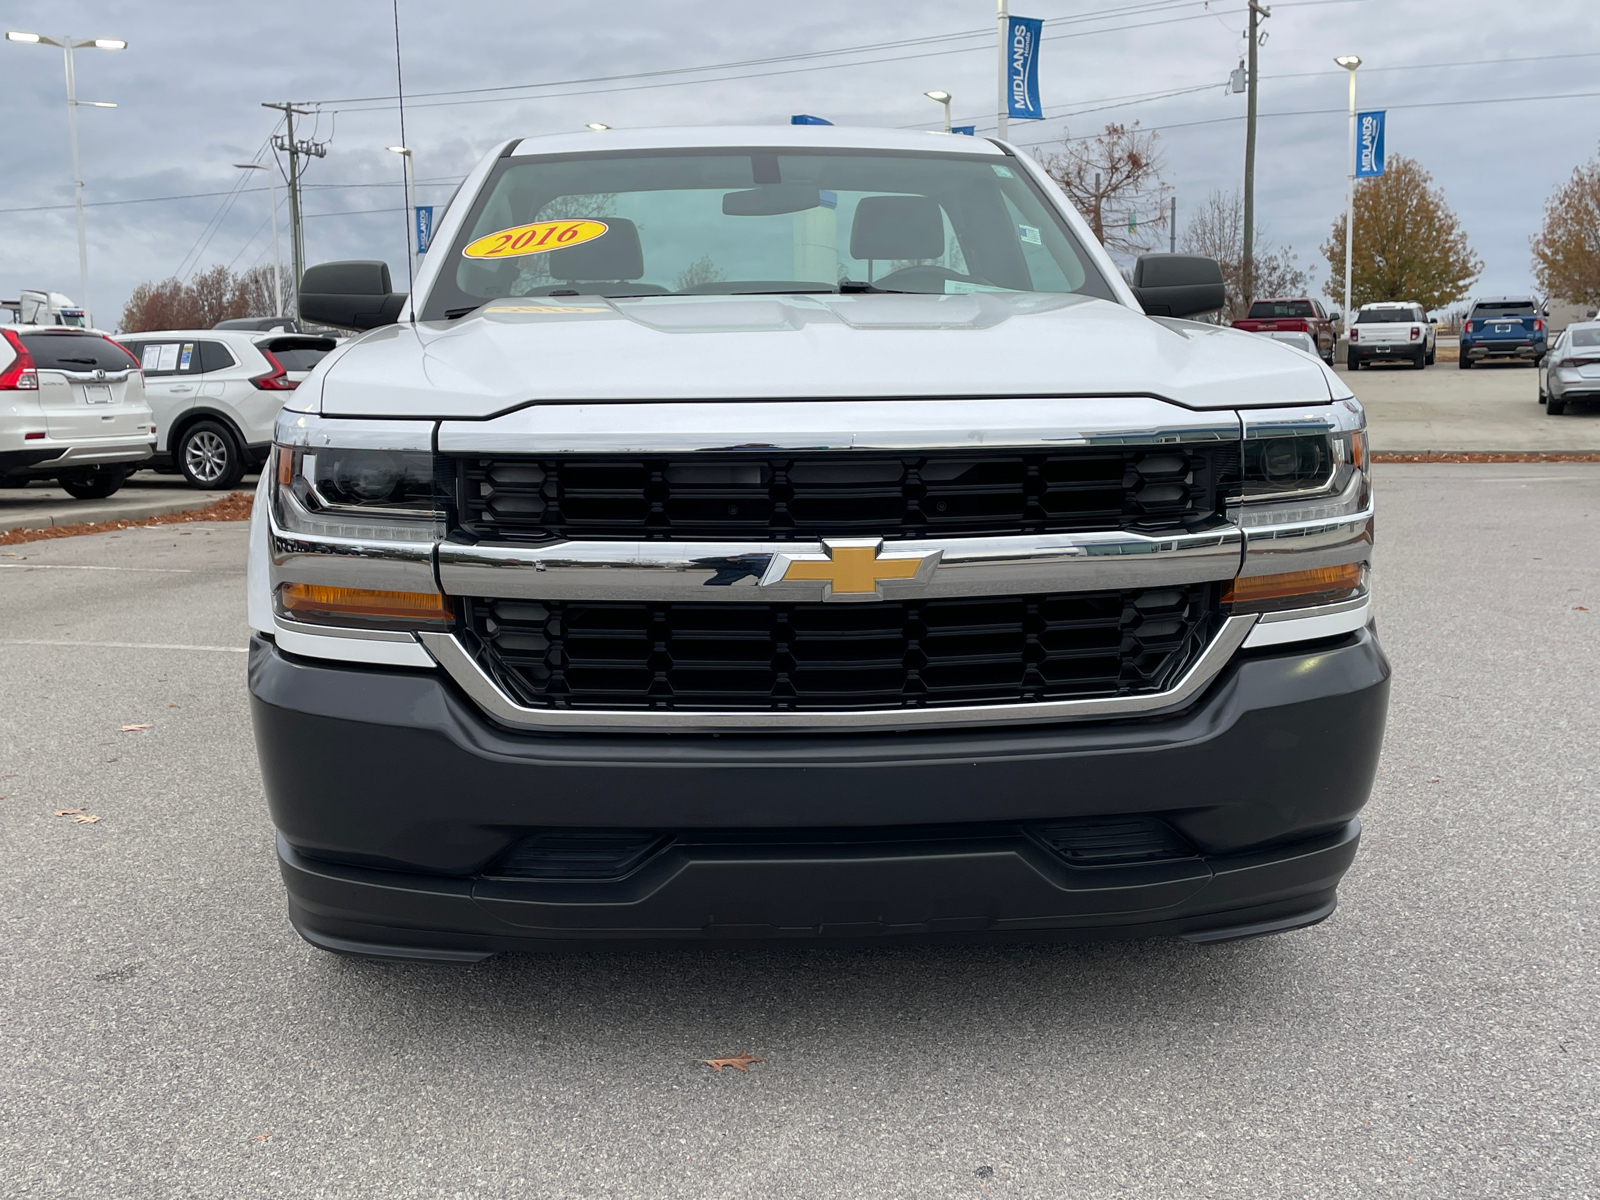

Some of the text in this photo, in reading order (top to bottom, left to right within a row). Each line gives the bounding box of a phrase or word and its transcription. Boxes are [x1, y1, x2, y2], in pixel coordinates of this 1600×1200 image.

[1013, 24, 1026, 109] MIDLANDS
[1361, 116, 1373, 172] MIDLANDS
[484, 222, 586, 255] 2016
